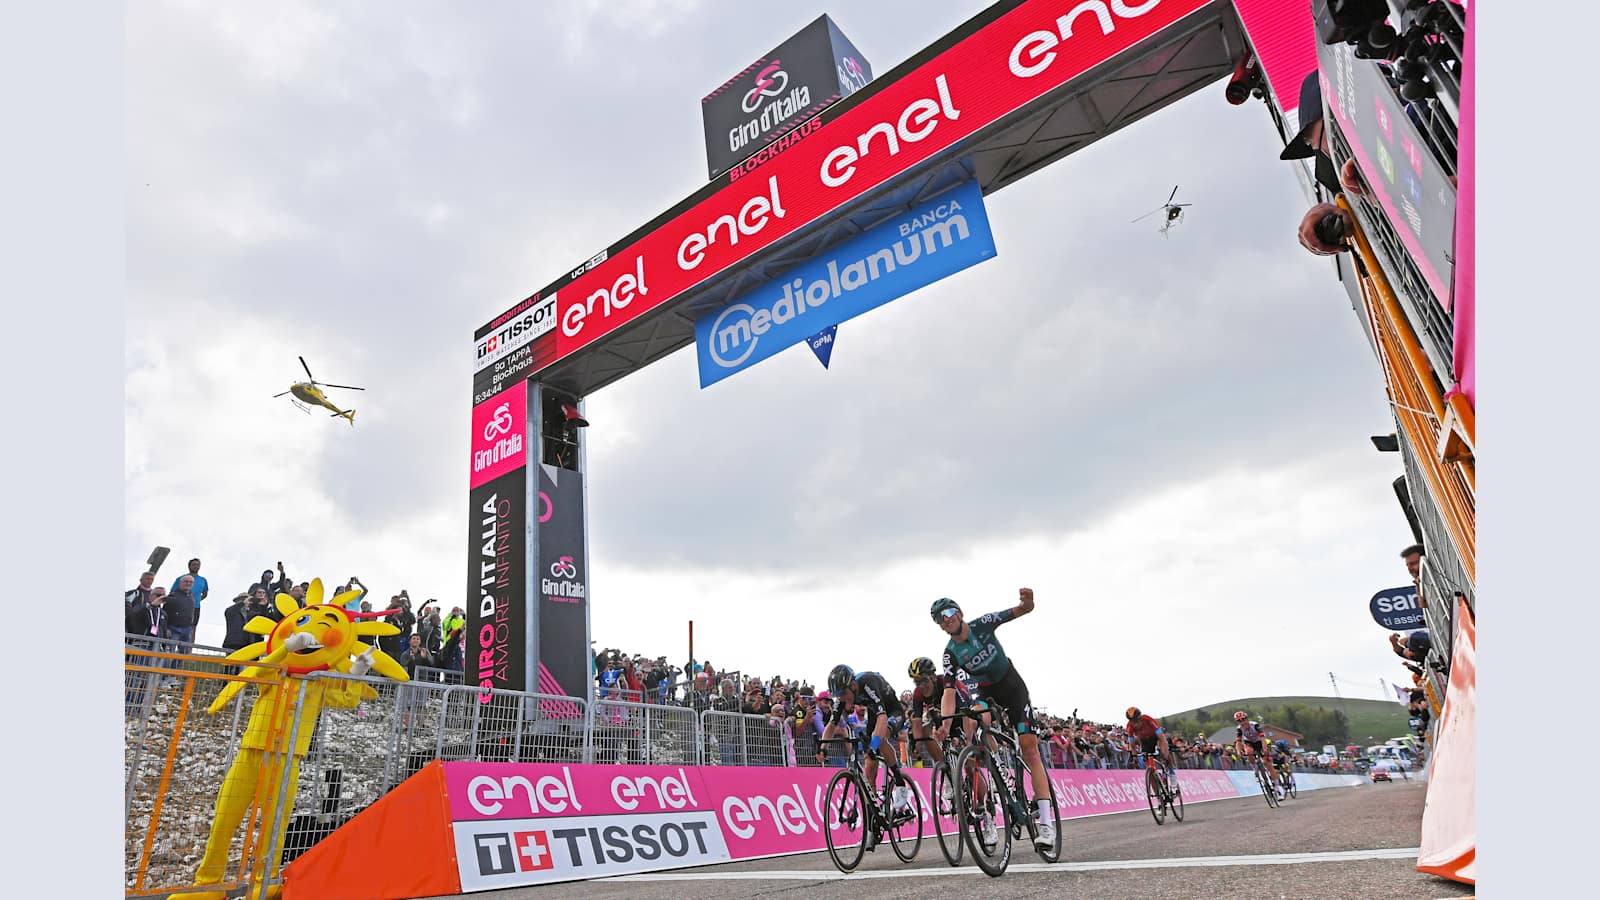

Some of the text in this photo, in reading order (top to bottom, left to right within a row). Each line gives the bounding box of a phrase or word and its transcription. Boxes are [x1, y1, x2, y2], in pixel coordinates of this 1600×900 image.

[729, 85, 810, 152] Giro d'Italia
[820, 73, 960, 188] enel
[730, 117, 822, 182] BLOCKHAUS
[677, 175, 786, 271] enel
[899, 199, 962, 237] BANCA
[562, 255, 648, 337] enel
[718, 214, 970, 354] mediolanum
[499, 301, 555, 345] TISSOT
[812, 334, 832, 349] GPM
[492, 356, 533, 385] Blockhaus
[507, 345, 531, 365] TAPPA
[475, 433, 522, 472] Giro d'Italia
[479, 493, 497, 704] GIRO D'ITALIA
[495, 499, 511, 682] AMORE INFINITO
[542, 578, 559, 596] Giro
[1377, 593, 1418, 613] sar
[1394, 614, 1424, 626] assic
[965, 643, 995, 669] BORA
[467, 766, 698, 816] enel enel
[723, 784, 819, 839] enel
[553, 821, 707, 867] TISSOT
